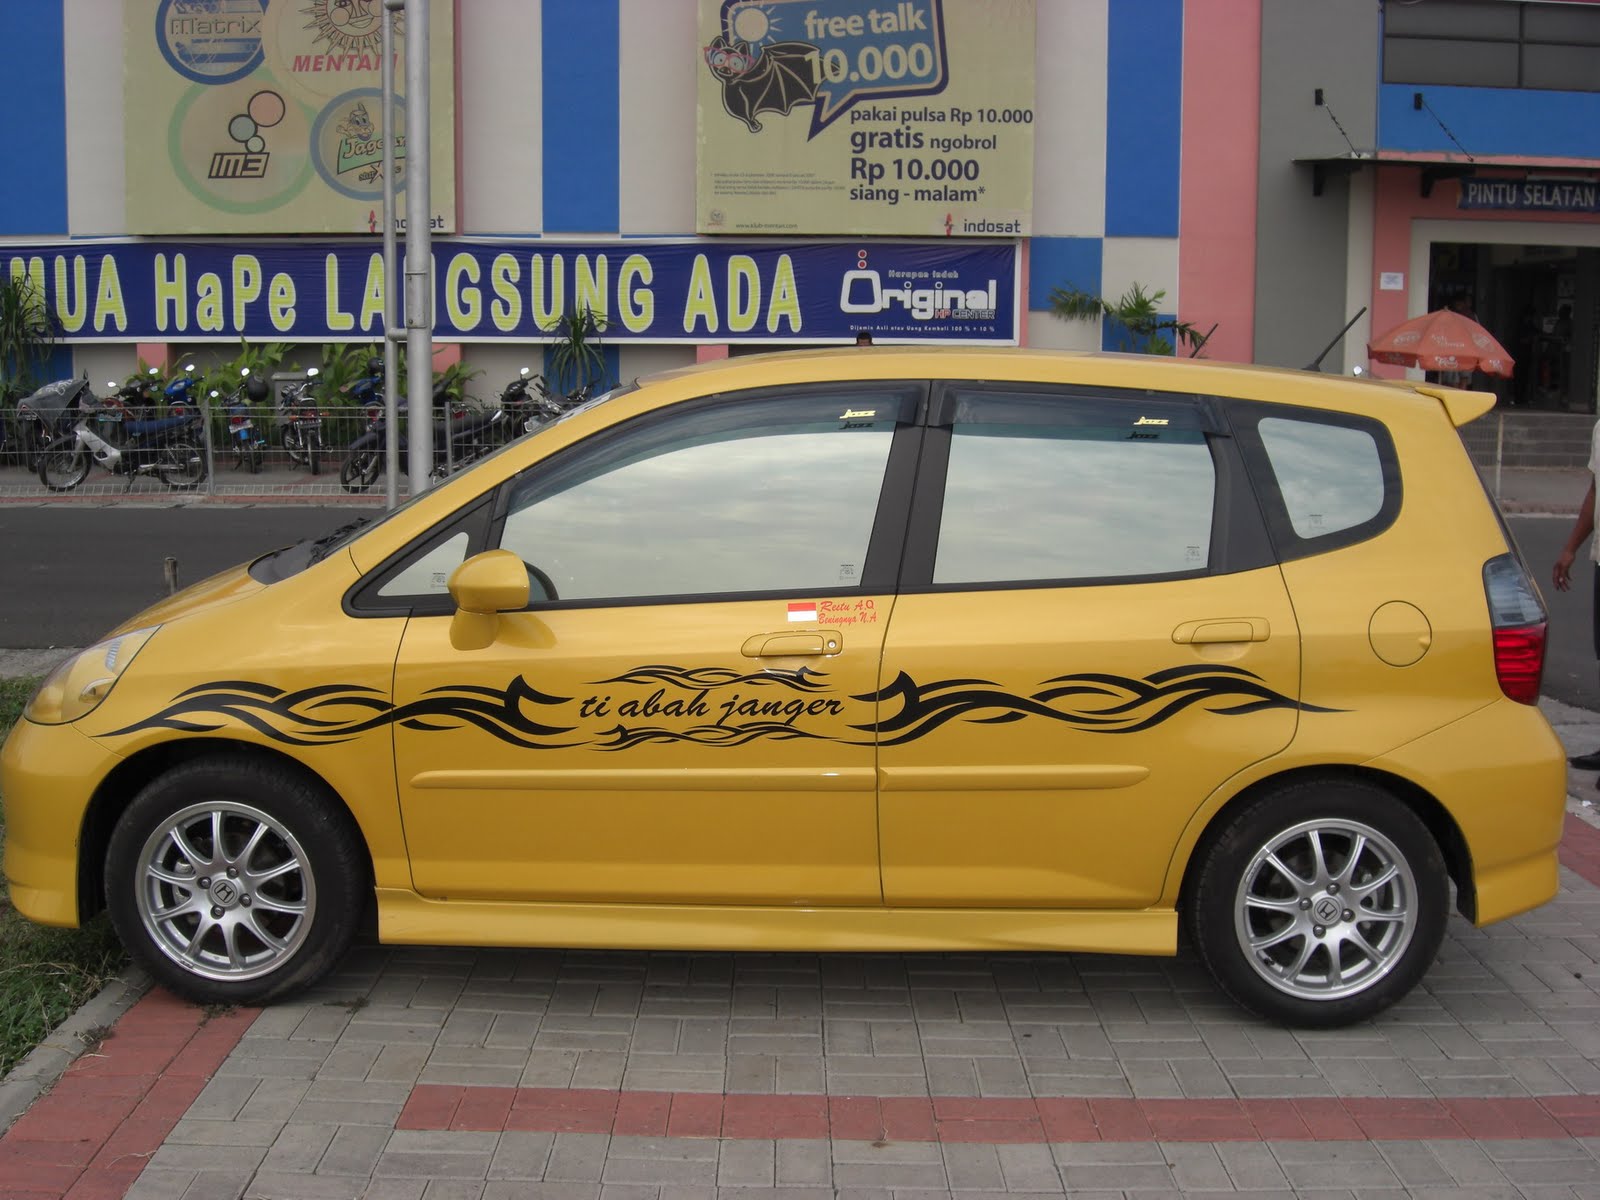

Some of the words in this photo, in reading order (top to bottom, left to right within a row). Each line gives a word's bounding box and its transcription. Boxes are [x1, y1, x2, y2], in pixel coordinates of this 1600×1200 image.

[171, 16, 262, 35] Matrix
[804, 10, 864, 40] free
[868, 2, 927, 34] talk
[804, 42, 933, 84] 10.000
[850, 106, 897, 125] pakai
[901, 107, 946, 125] pulsa
[950, 107, 972, 126] Rp
[977, 108, 1034, 124] 10.000
[850, 125, 924, 154] gratis
[930, 134, 997, 152] ngobrol
[208, 152, 271, 179] IM3
[850, 157, 885, 186] Rp
[892, 158, 980, 181] 10.000
[850, 184, 899, 205] siang
[1468, 183, 1517, 205] PINTU
[1523, 184, 1596, 208] SELATAN
[963, 219, 1021, 233] indosat
[0, 253, 128, 333] MUA
[153, 252, 297, 332] HaPe
[325, 252, 655, 333] LAGSUNG
[683, 253, 803, 334] ADA
[840, 269, 997, 320] Original
[934, 308, 951, 319] HP
[951, 309, 996, 320] CENTER
[579, 695, 611, 718] ti
[617, 688, 711, 718] abah
[715, 694, 845, 727] janger
